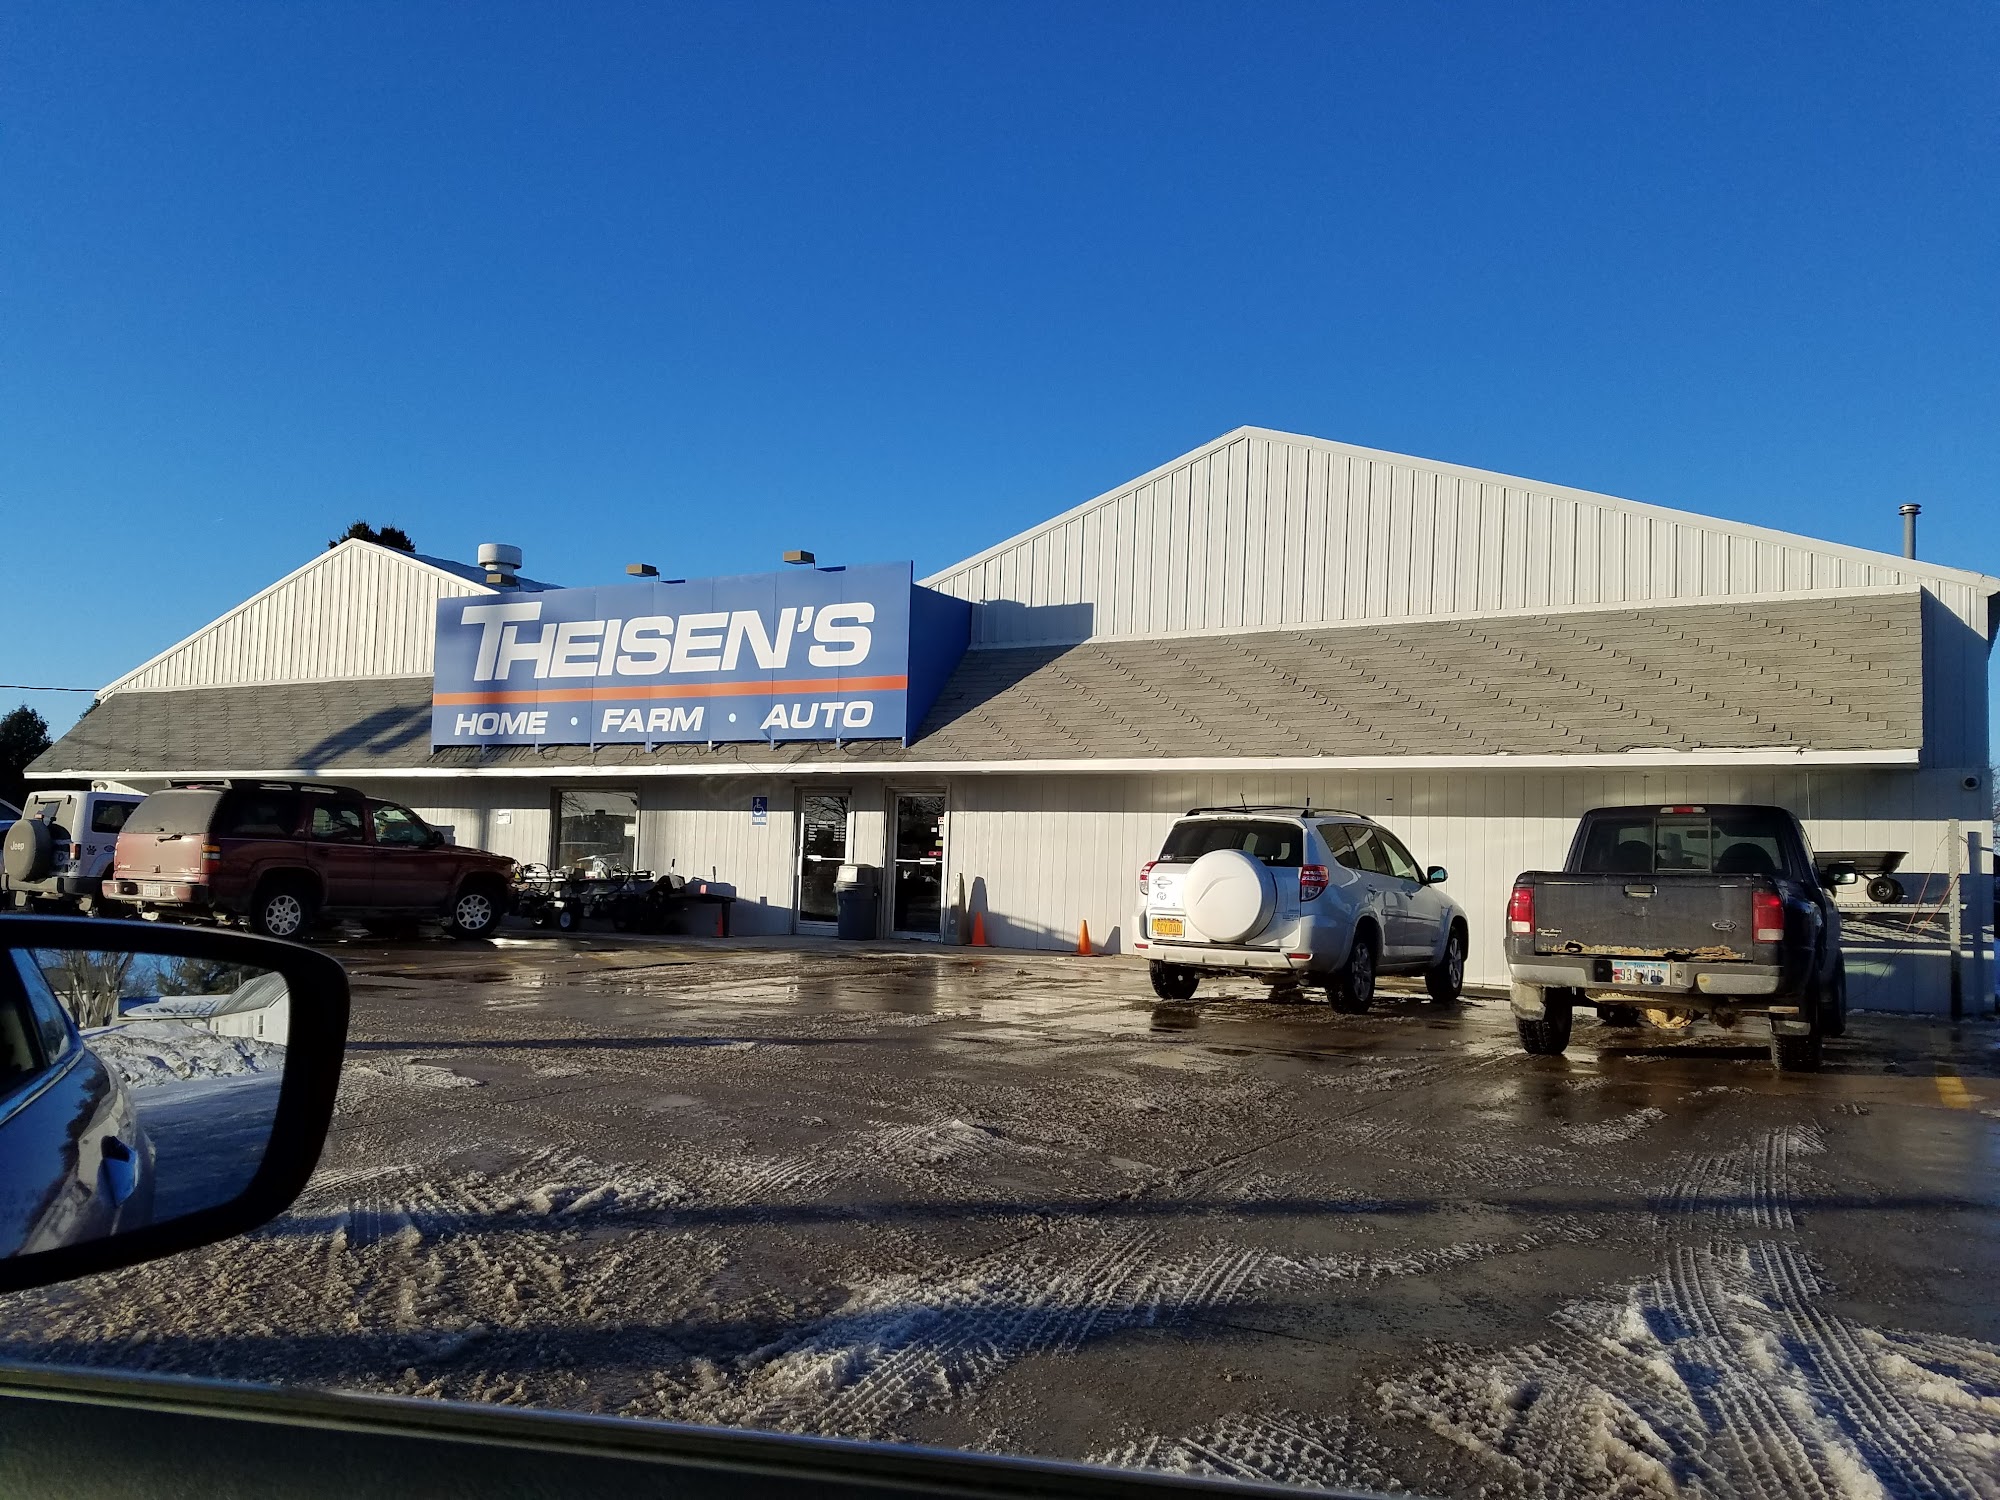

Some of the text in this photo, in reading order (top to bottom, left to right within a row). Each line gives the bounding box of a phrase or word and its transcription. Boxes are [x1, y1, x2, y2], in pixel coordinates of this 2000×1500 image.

[461, 602, 875, 681] THEISEN'S
[454, 701, 874, 735] HOME FARM AUTO
[10, 841, 25, 851] Jeep
